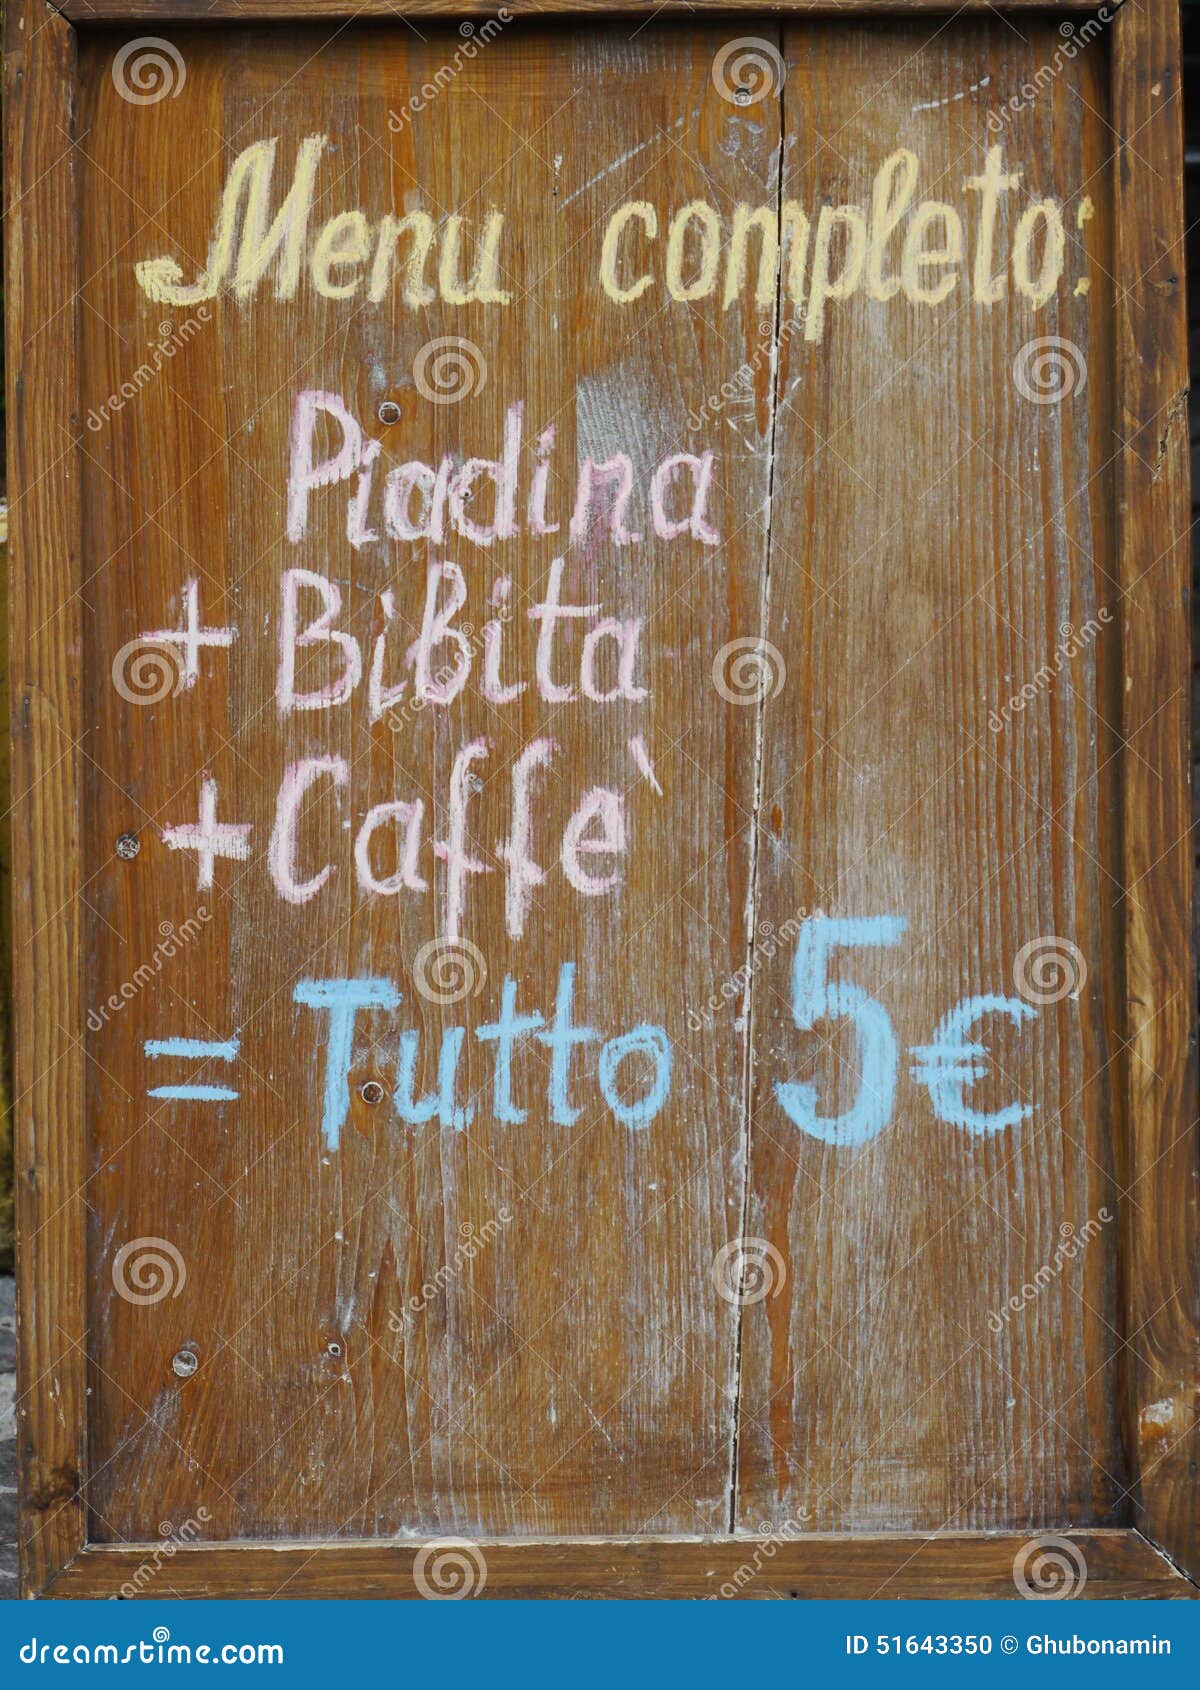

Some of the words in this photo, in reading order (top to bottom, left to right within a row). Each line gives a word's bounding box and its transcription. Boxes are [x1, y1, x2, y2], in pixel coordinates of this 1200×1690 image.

[134, 132, 511, 309] Menu
[599, 144, 1094, 344] completo:
[286, 390, 720, 549] Piadina
[140, 577, 235, 691] +
[277, 557, 648, 724] Bibita
[292, 961, 674, 1152] Tutto
